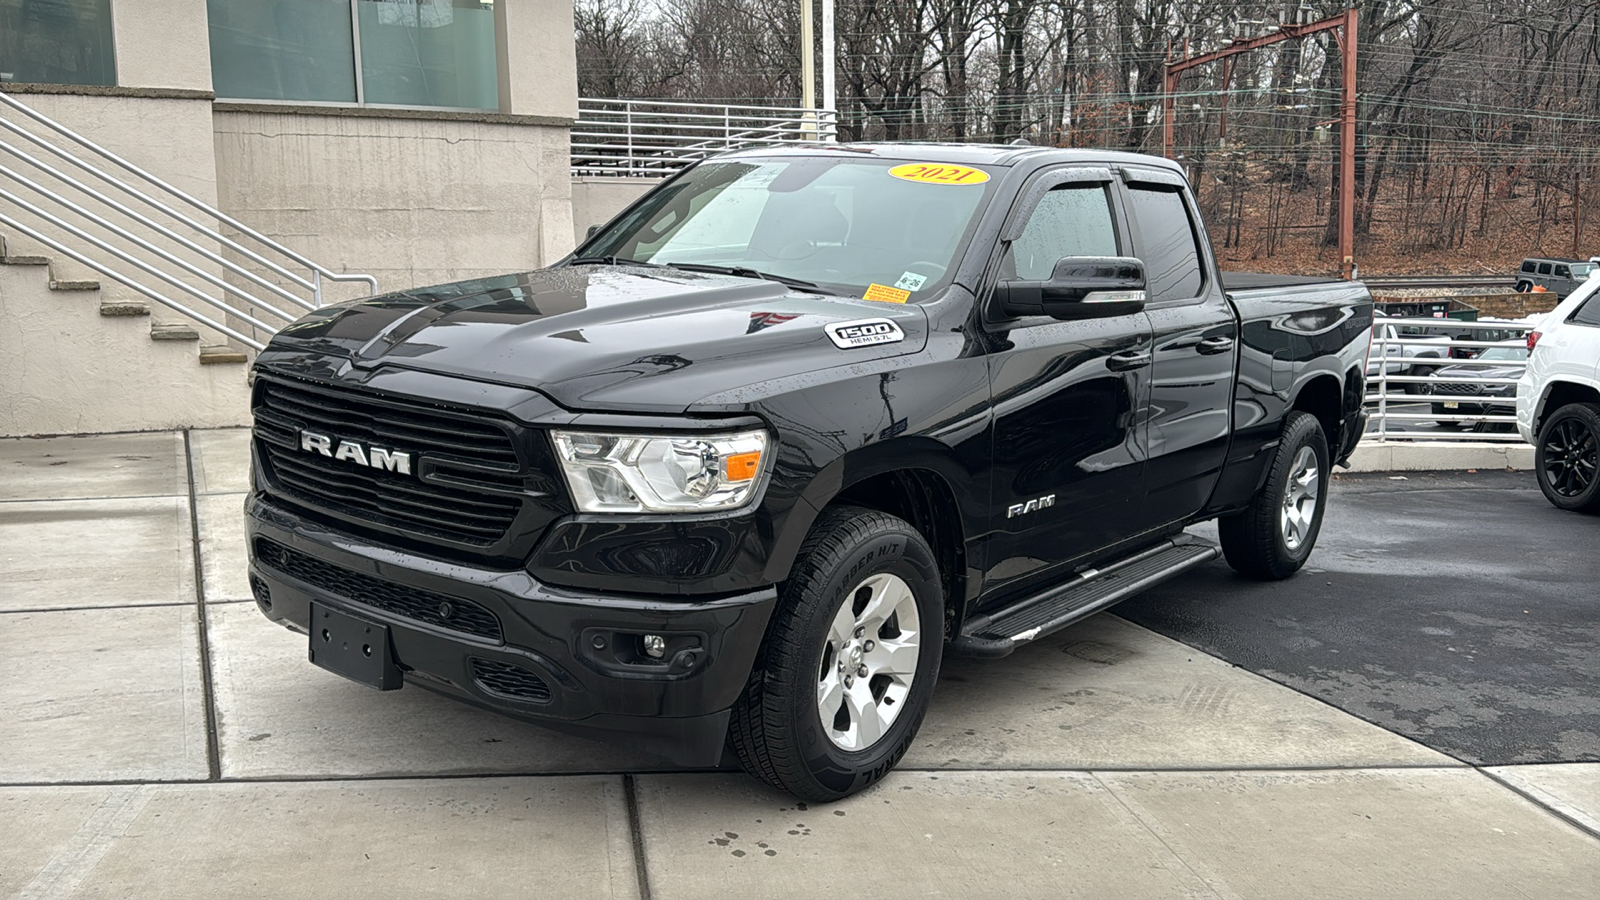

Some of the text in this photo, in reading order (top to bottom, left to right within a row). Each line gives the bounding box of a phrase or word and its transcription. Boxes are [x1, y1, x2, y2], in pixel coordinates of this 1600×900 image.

[903, 166, 975, 181] 2021
[837, 323, 891, 339] 1500
[850, 337, 872, 345] HEMI
[301, 430, 411, 476] RAM
[1007, 494, 1056, 519] RAM
[877, 542, 899, 557] H/T
